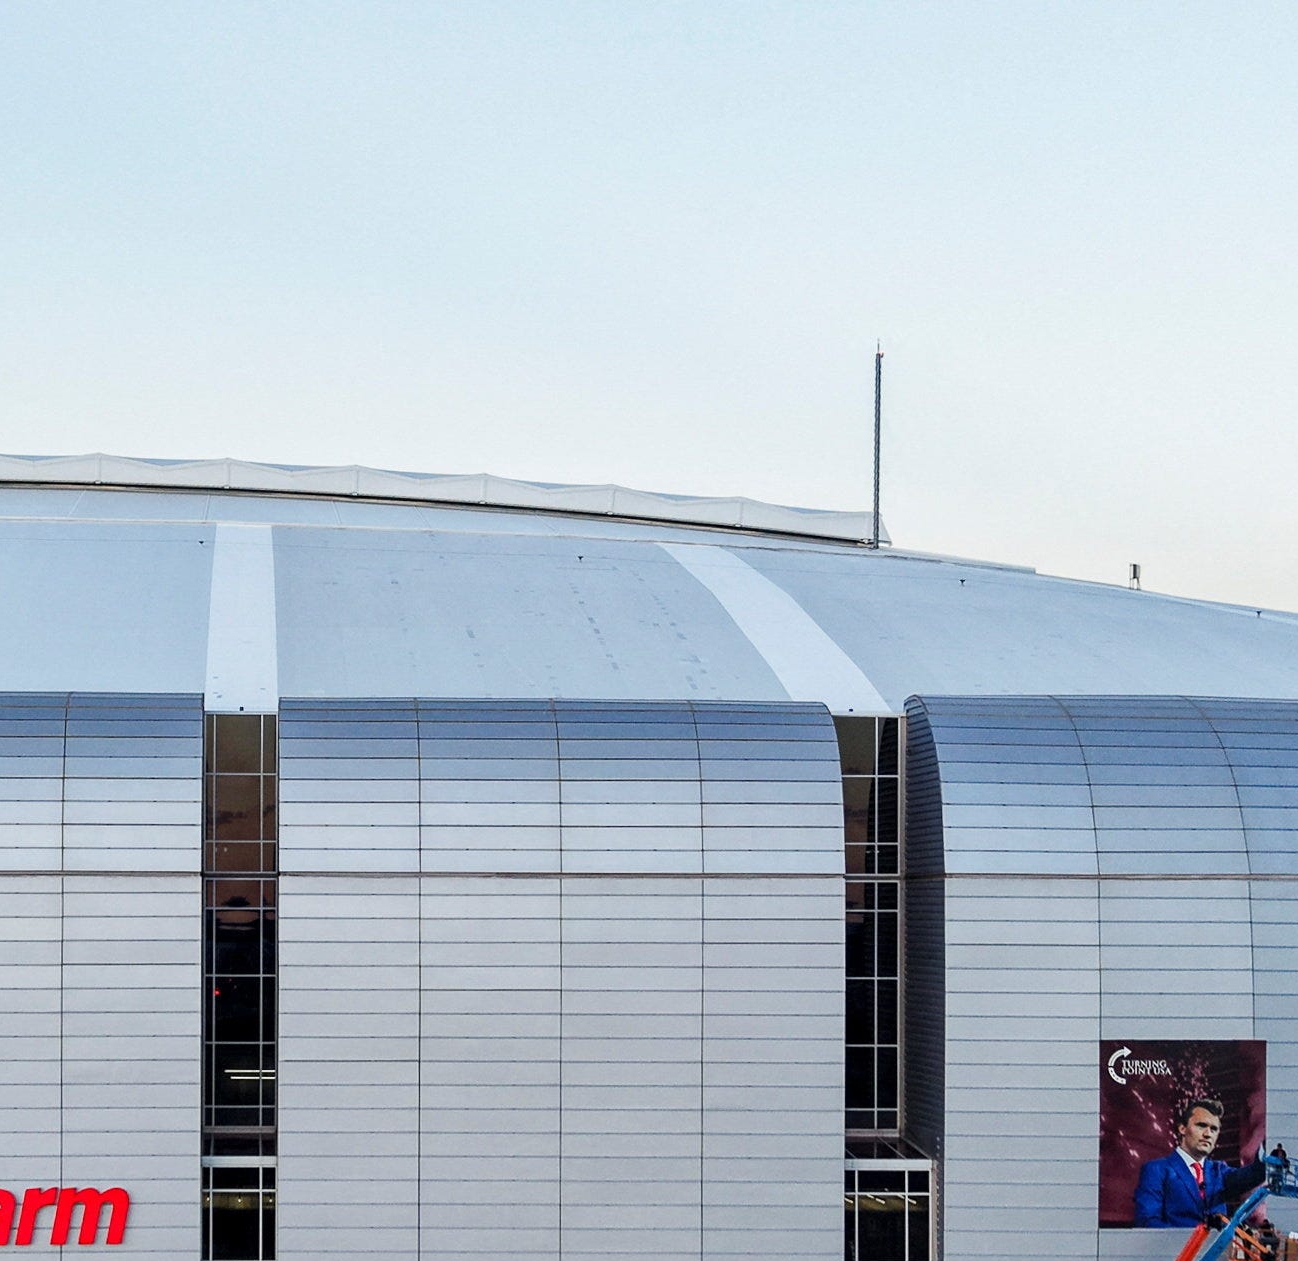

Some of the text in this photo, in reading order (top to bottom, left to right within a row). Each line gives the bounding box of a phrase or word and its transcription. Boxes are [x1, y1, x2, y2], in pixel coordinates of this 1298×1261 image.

[1122, 1059, 1167, 1068] TURNING
[1122, 1066, 1172, 1075] POINT USA
